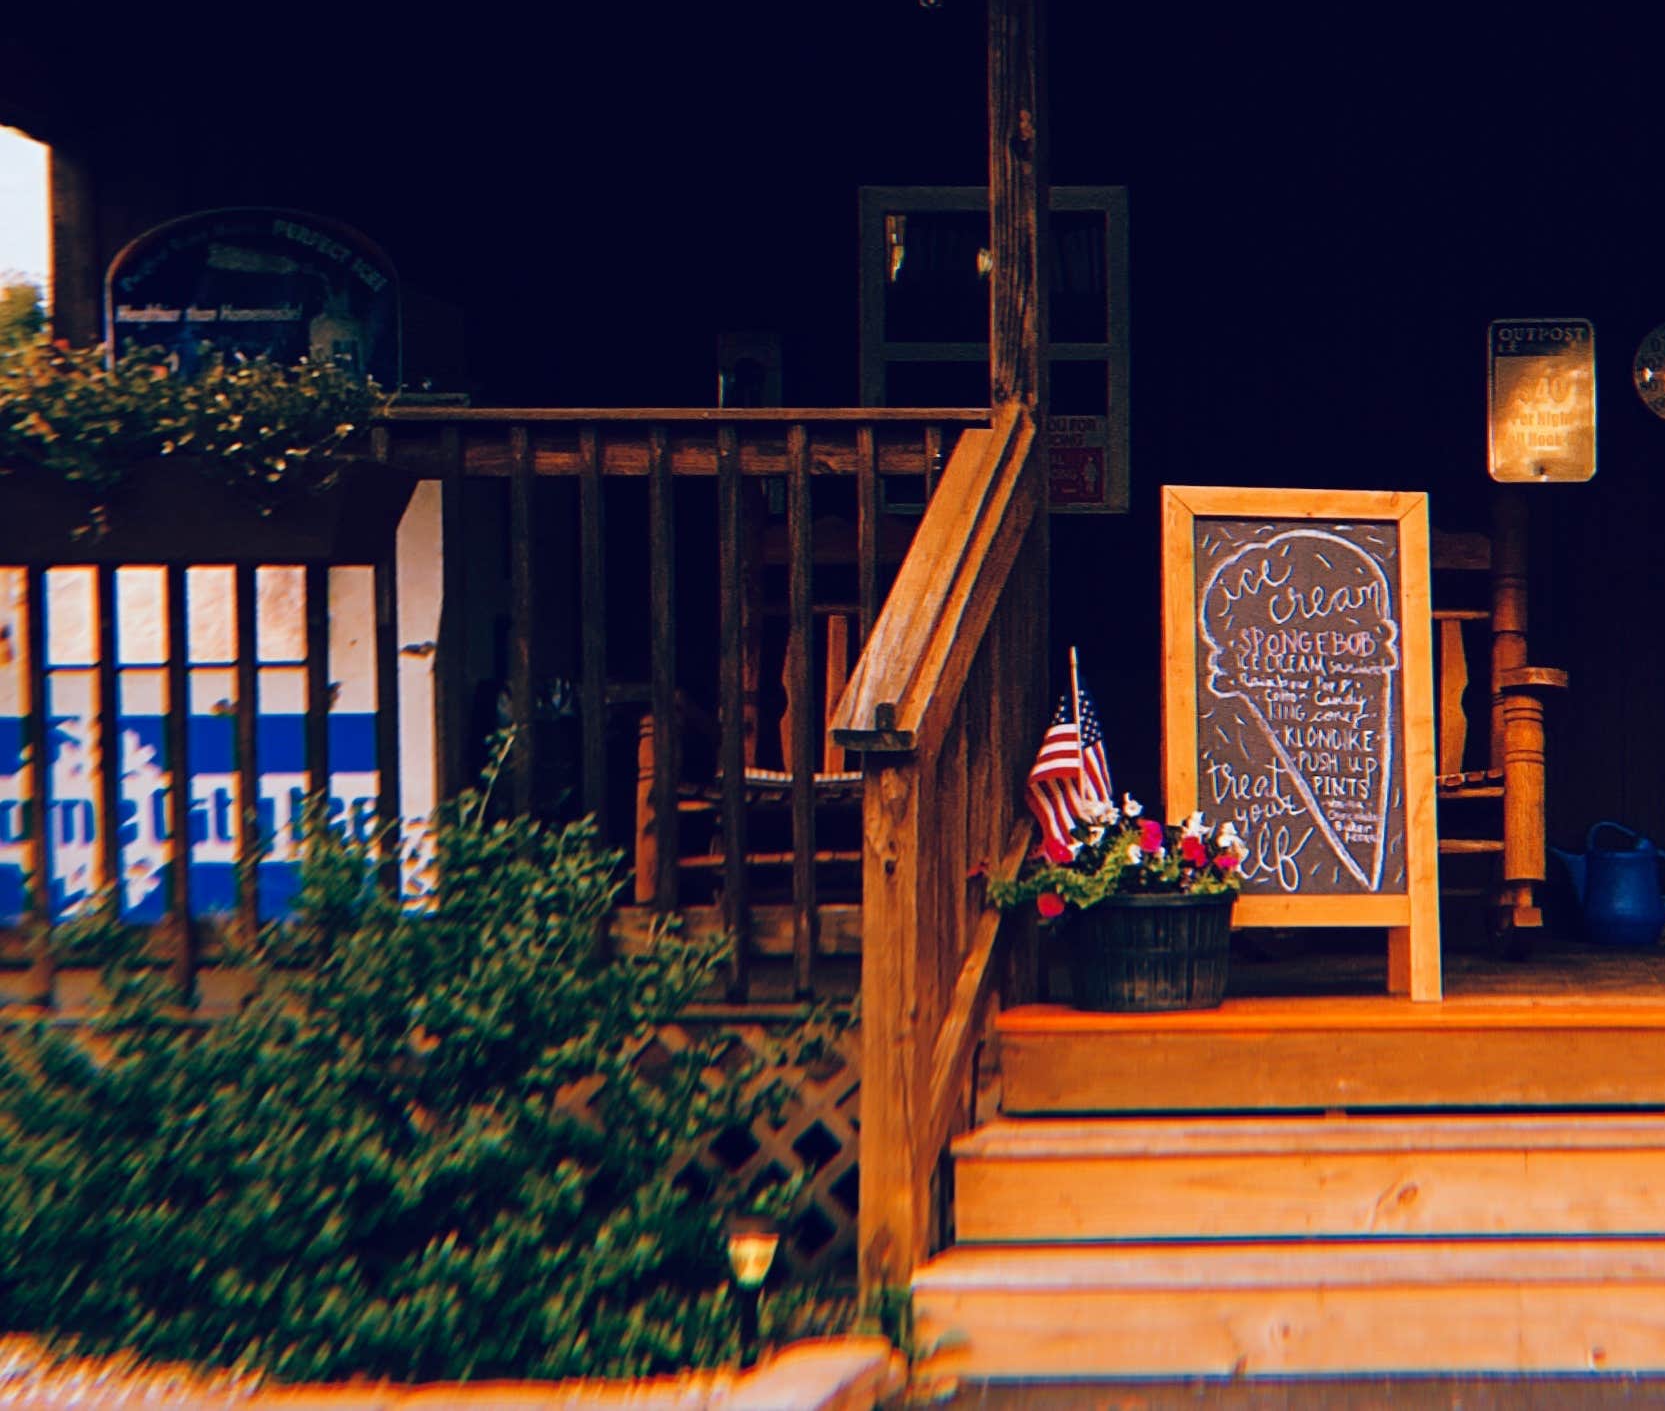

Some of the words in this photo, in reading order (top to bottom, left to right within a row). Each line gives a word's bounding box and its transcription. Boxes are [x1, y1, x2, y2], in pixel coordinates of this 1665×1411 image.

[1499, 327, 1587, 341] OUTPOST
[1218, 559, 1293, 617] ice
[1269, 579, 1383, 624] cream
[1240, 626, 1377, 657] SPONGEBOB
[1284, 724, 1375, 752] KLONDIKE
[1312, 774, 1371, 799] PINTS
